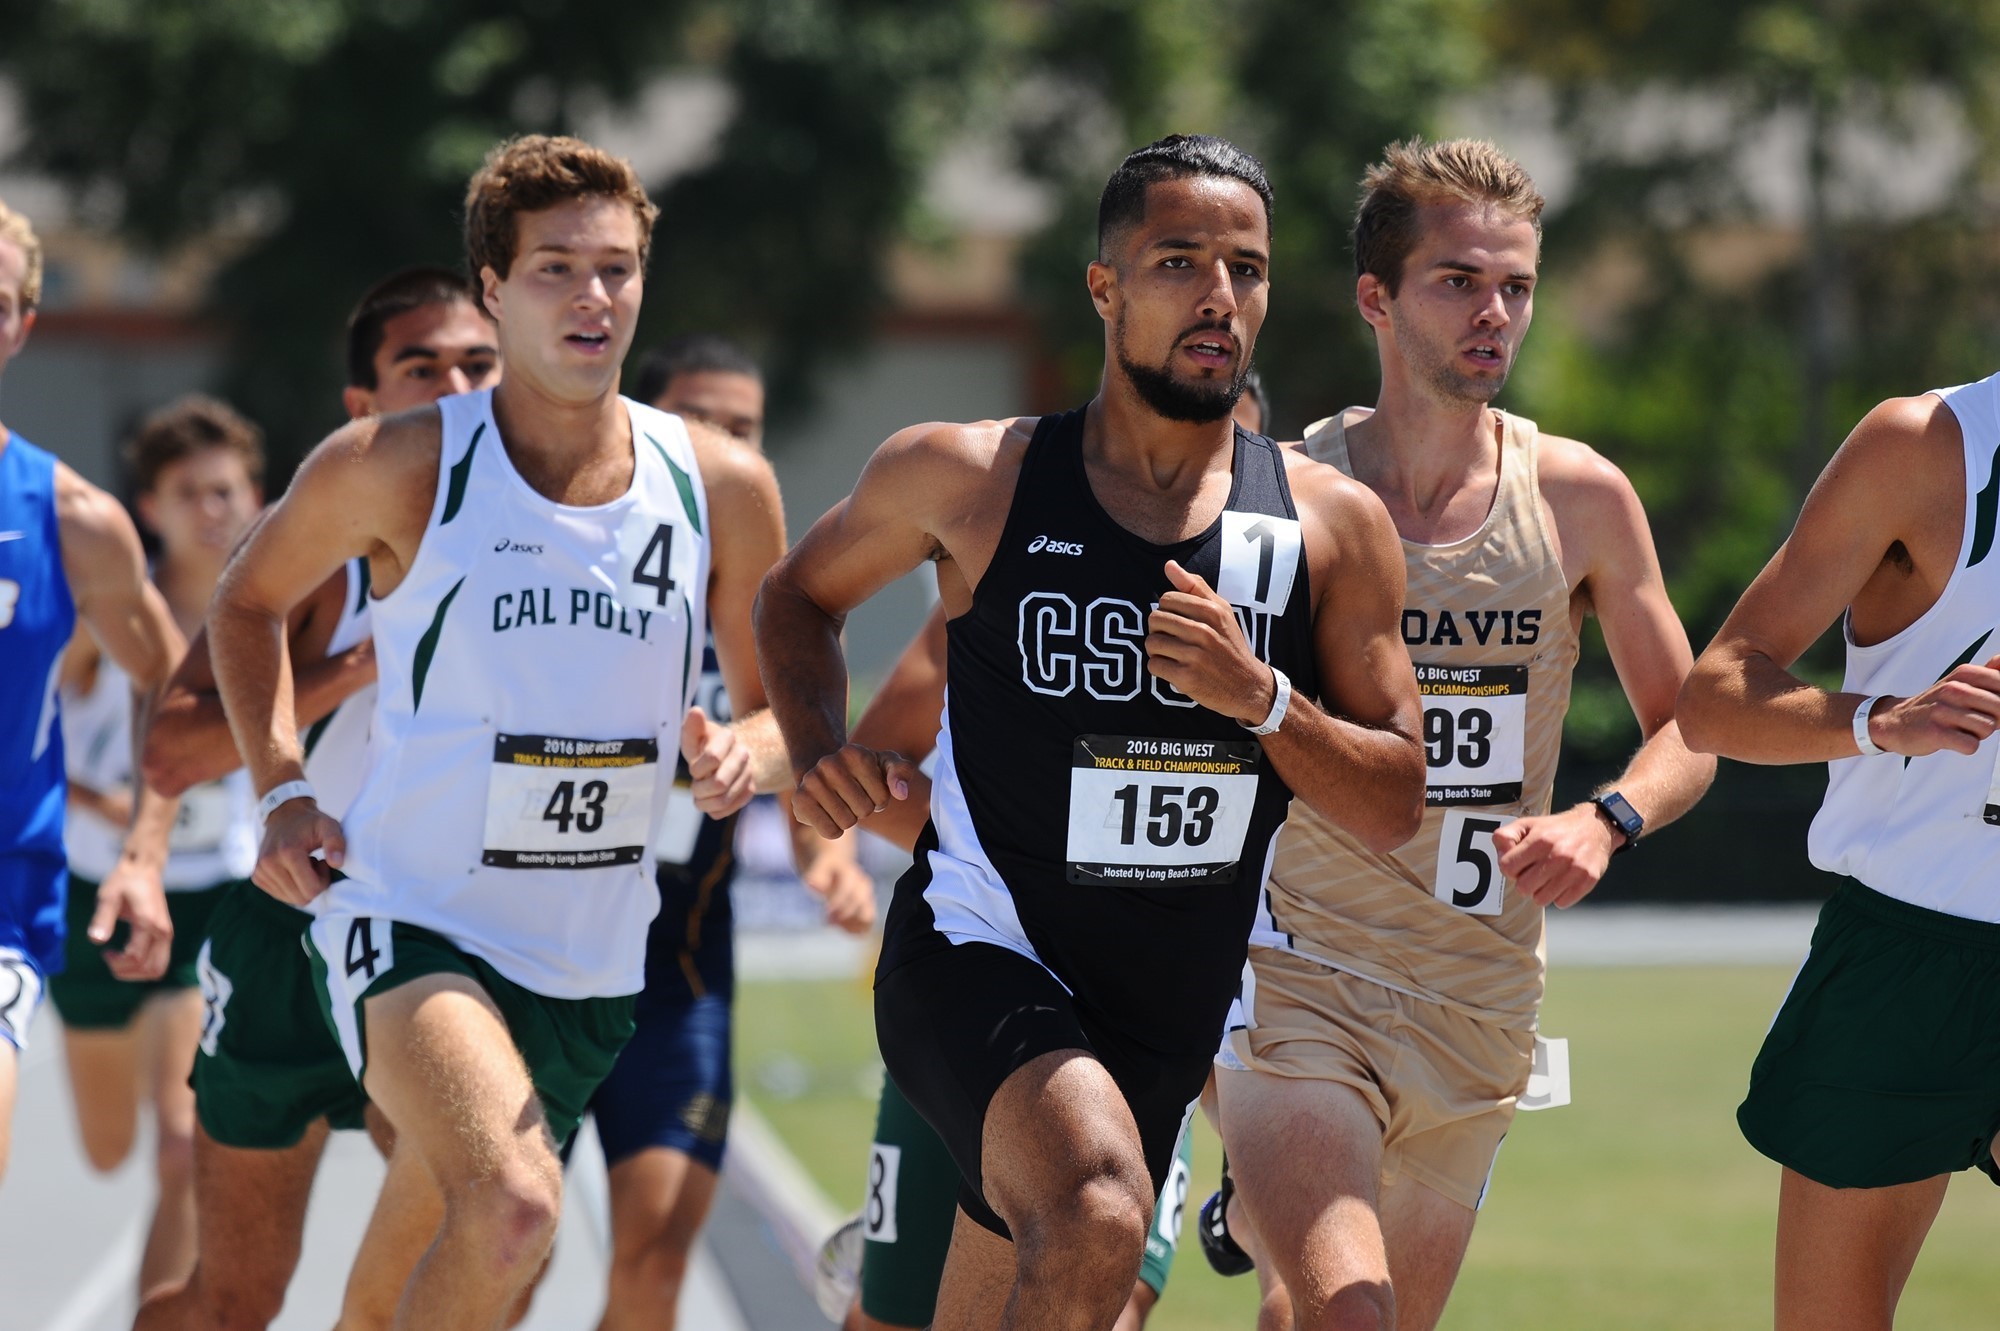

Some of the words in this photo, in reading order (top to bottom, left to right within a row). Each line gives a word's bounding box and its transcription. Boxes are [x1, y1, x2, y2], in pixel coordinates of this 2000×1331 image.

[632, 523, 676, 607] 4
[1045, 539, 1084, 556] asics
[1243, 519, 1276, 604] 1
[493, 587, 556, 633] CAL
[568, 588, 652, 641] POLY
[1401, 609, 1542, 646] DAVIS
[1017, 591, 1273, 709] CS
[1428, 667, 1448, 680] BIG
[1450, 669, 1482, 683] WEST
[1432, 684, 1510, 696] CHAMPIONSHIPS
[543, 738, 575, 755] 2016
[576, 740, 595, 756] BIG
[595, 741, 624, 755] WEST
[1126, 740, 1158, 755] 2016
[1160, 742, 1181, 757] BIG
[1184, 743, 1215, 758] WEST
[1422, 708, 1493, 768] 93
[1095, 756, 1125, 769] TRACK
[1127, 758, 1135, 770] &
[1136, 759, 1162, 771] FIELD
[1163, 760, 1241, 774] CHAMPIONSHIPS
[543, 780, 609, 833] 43
[1114, 784, 1220, 847] 153
[1425, 790, 1443, 801] ong
[1445, 787, 1469, 799] Beach
[1471, 787, 1492, 798] State
[1103, 867, 1134, 878] Hosted
[1134, 868, 1145, 881] by
[1146, 868, 1166, 881] Long
[1167, 868, 1189, 879] Beach
[1190, 867, 1208, 878] State
[1452, 817, 1501, 908] 5
[345, 917, 381, 979] 4
